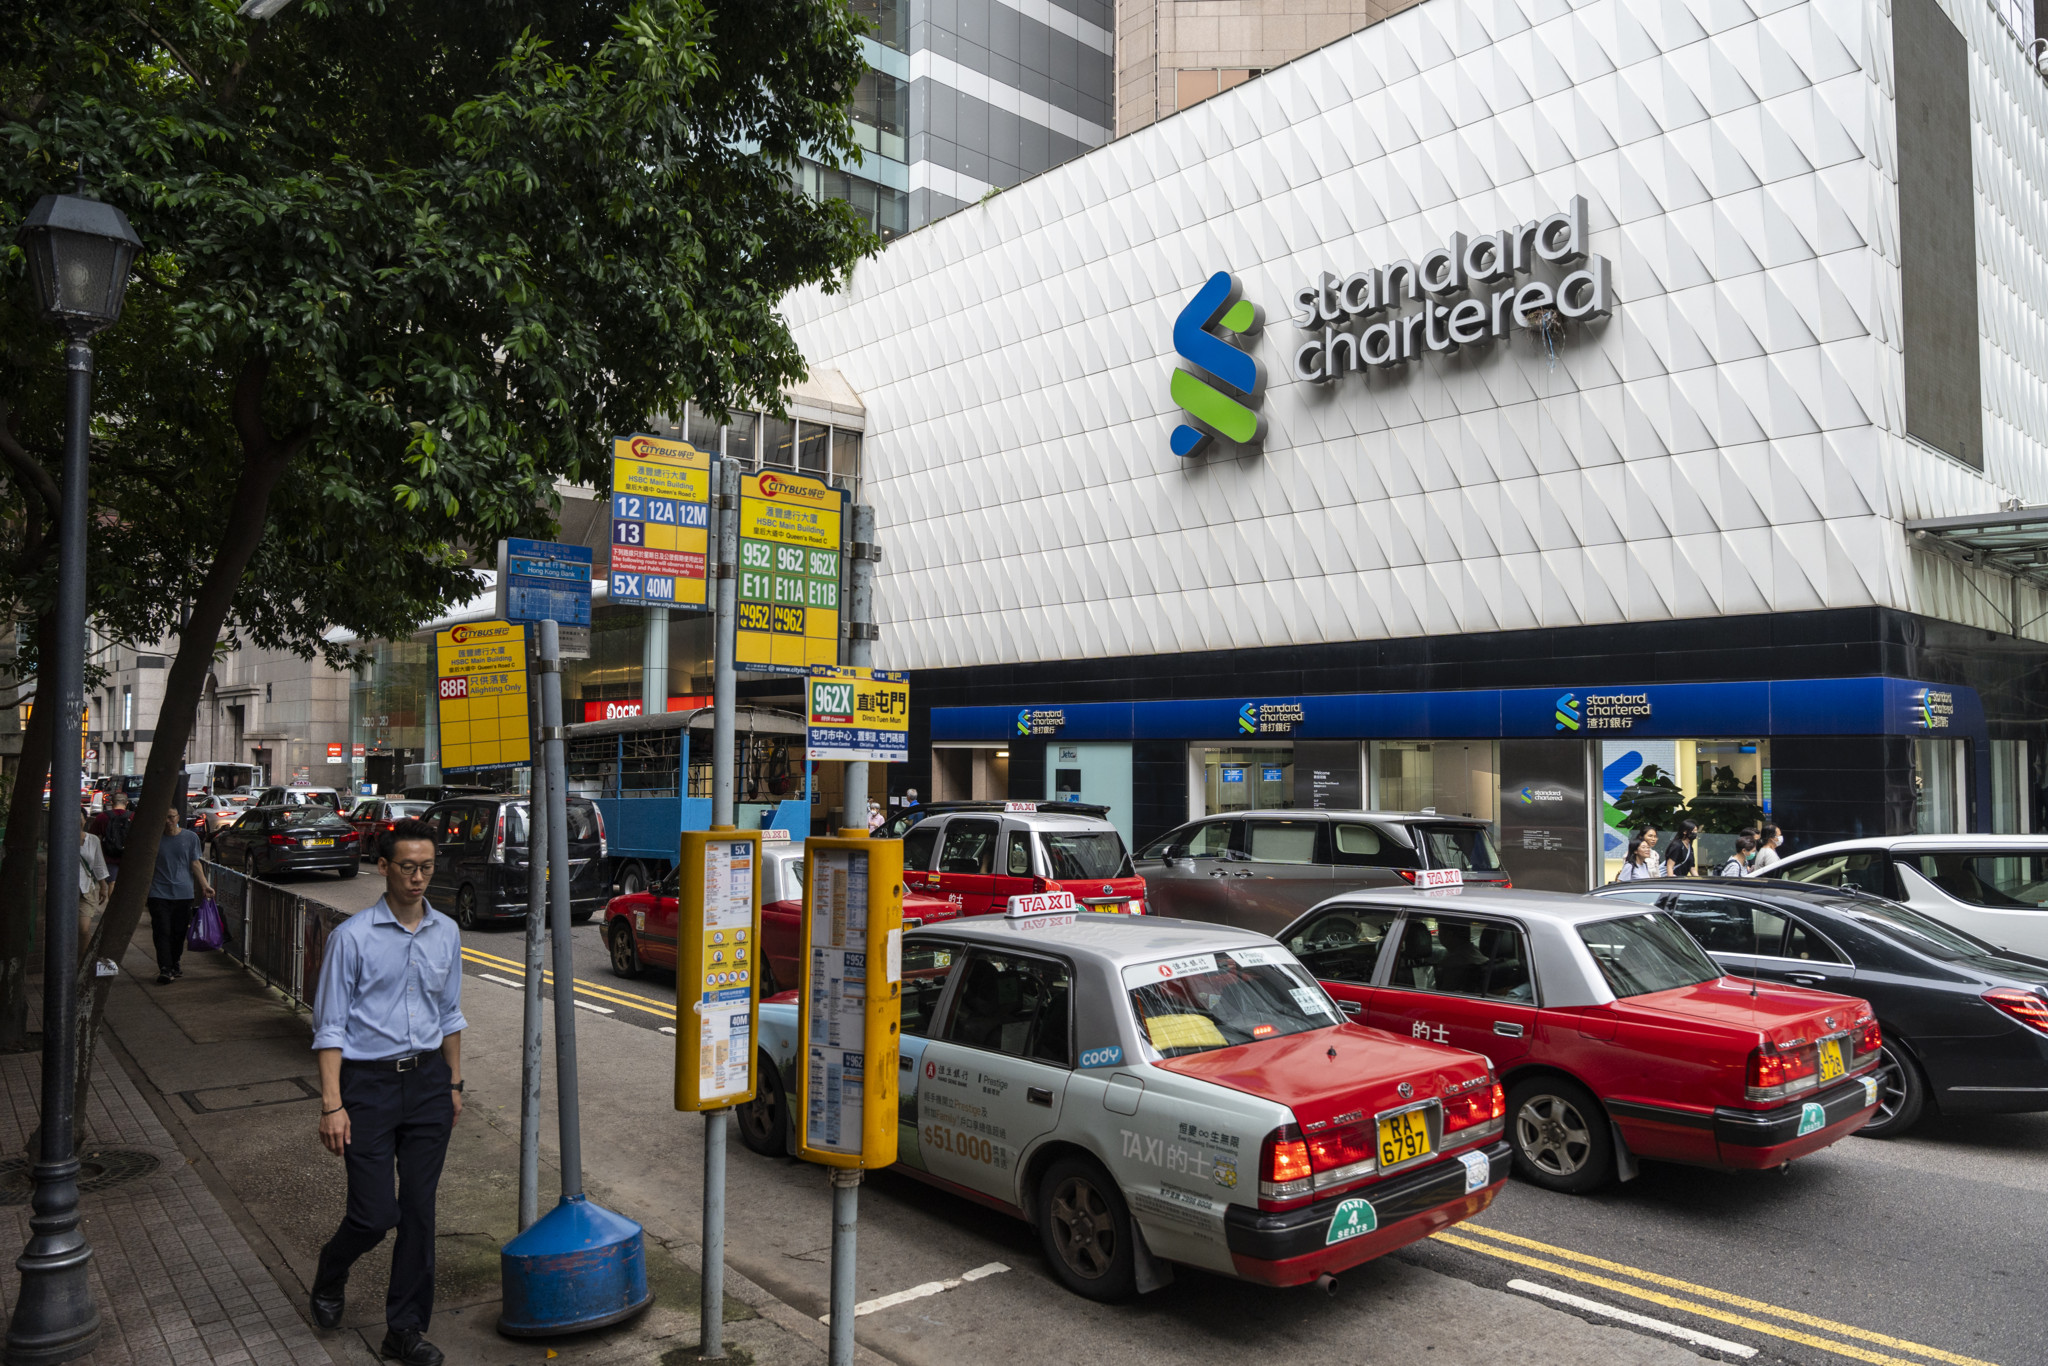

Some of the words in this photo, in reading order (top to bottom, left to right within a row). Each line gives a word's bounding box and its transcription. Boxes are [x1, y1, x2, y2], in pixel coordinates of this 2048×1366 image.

[1293, 194, 1588, 330] standard
[1294, 253, 1612, 383] chartered
[640, 445, 677, 457] CITYBUS
[628, 475, 648, 484] HSBC
[650, 479, 665, 487] Main
[667, 480, 694, 491] Building
[769, 482, 807, 496] CITYBUS
[656, 486, 677, 496] Queen's
[678, 488, 692, 497] Road
[618, 497, 640, 518] 12
[648, 501, 674, 524] 12A
[680, 504, 707, 526] 12M
[617, 523, 640, 543] 13
[756, 517, 777, 527] HSBC
[778, 520, 795, 530] Main
[797, 523, 825, 536] Building
[753, 526, 784, 537] 皇后大道中
[786, 532, 808, 541] Queen's
[808, 535, 822, 543] Road
[743, 542, 770, 568] 952
[778, 547, 804, 572] 962
[528, 566, 543, 576] Hong
[544, 568, 559, 577] Kong
[620, 562, 637, 570] Sunday
[647, 565, 661, 573] Public
[661, 566, 679, 575] Holiday
[679, 568, 690, 576] only
[622, 557, 644, 566] following
[667, 560, 685, 568] observe
[694, 563, 705, 571] stop
[810, 552, 837, 577] 962X
[614, 574, 640, 596] 5X
[646, 578, 672, 598] 40M
[743, 573, 769, 598] E11
[775, 576, 804, 603] E11A
[809, 581, 836, 606] E11B
[740, 603, 769, 629] N952
[775, 607, 803, 632] N962
[460, 628, 493, 639] CITYBUS
[487, 655, 512, 663] Building
[812, 667, 826, 675] 屯門
[470, 674, 508, 686] 只供落客
[440, 679, 467, 697] 88R
[470, 685, 503, 695] Alighting
[815, 685, 851, 713] 962X
[1587, 693, 1648, 705] standard
[616, 704, 641, 718] OCBC
[1033, 710, 1062, 718] standard
[1260, 703, 1300, 713] standard
[1587, 704, 1651, 716] chartered
[1033, 717, 1065, 725] chartered
[1260, 712, 1304, 722] chartered
[1587, 718, 1633, 728] 渣打銀行
[811, 729, 853, 741] 屯門市中心
[1260, 723, 1291, 732] 渣打銀行
[1012, 802, 1035, 811] TAXI
[762, 830, 788, 839] AXI
[735, 845, 746, 855] 5X
[1427, 870, 1460, 885] TAXI
[1020, 894, 1072, 912] TAXI
[1103, 905, 1112, 913] YC
[732, 1015, 748, 1026] 40M
[1412, 1020, 1450, 1044] 的士
[845, 1055, 863, 1068] N962
[1082, 1048, 1119, 1066] cody
[983, 1075, 1009, 1091] Prestige
[1389, 1114, 1413, 1139] RA
[1120, 1128, 1164, 1168] TAXI
[1166, 1144, 1211, 1180] 的士
[1382, 1132, 1424, 1164] 6797
[1341, 1200, 1364, 1213] TAXI
[1348, 1210, 1358, 1225] 4
[1337, 1223, 1367, 1239] SEATS
